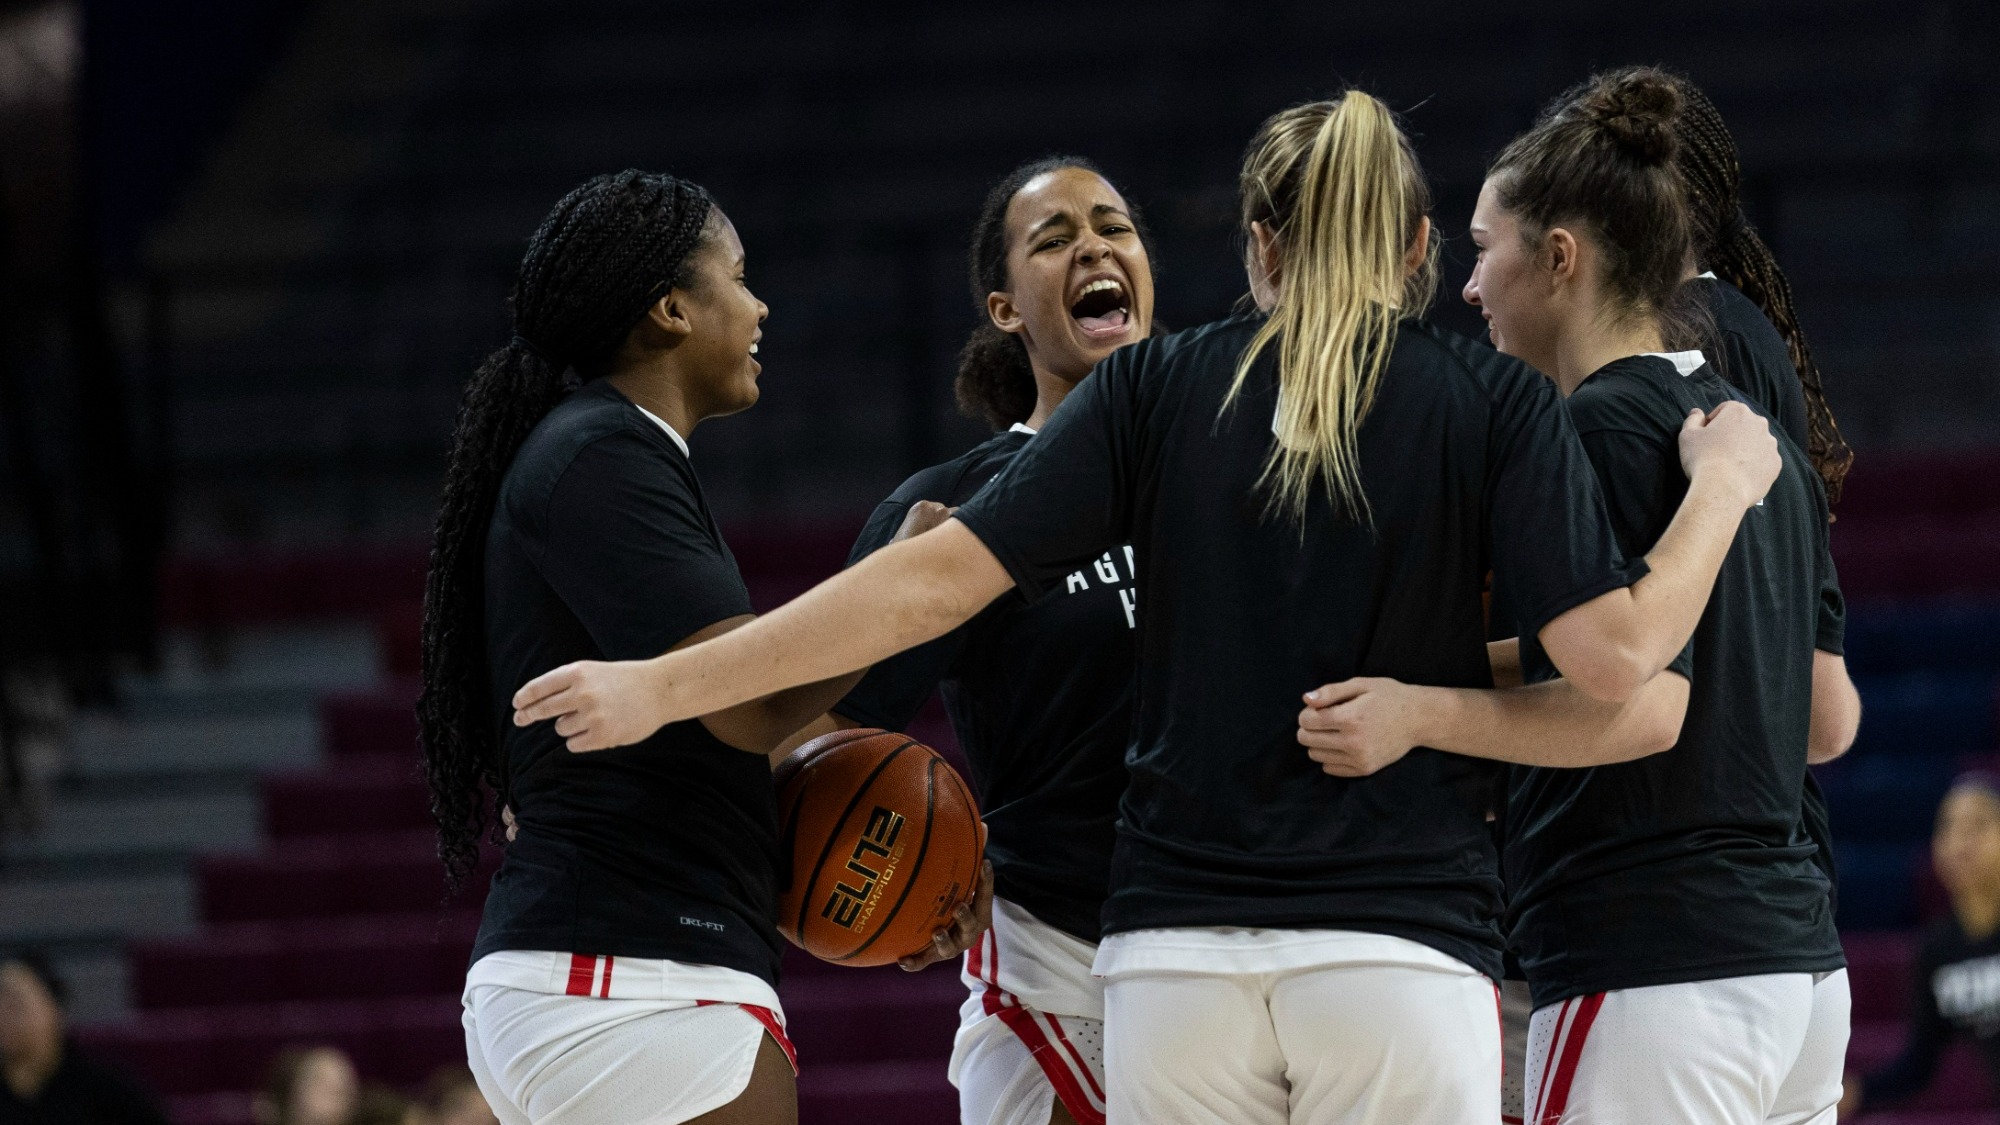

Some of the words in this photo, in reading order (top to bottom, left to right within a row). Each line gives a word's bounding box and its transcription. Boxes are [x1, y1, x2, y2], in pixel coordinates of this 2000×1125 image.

[680, 916, 725, 932] DRI-FIT
[821, 805, 906, 929] ELITE
[854, 818, 915, 934] CHAMPIONS
